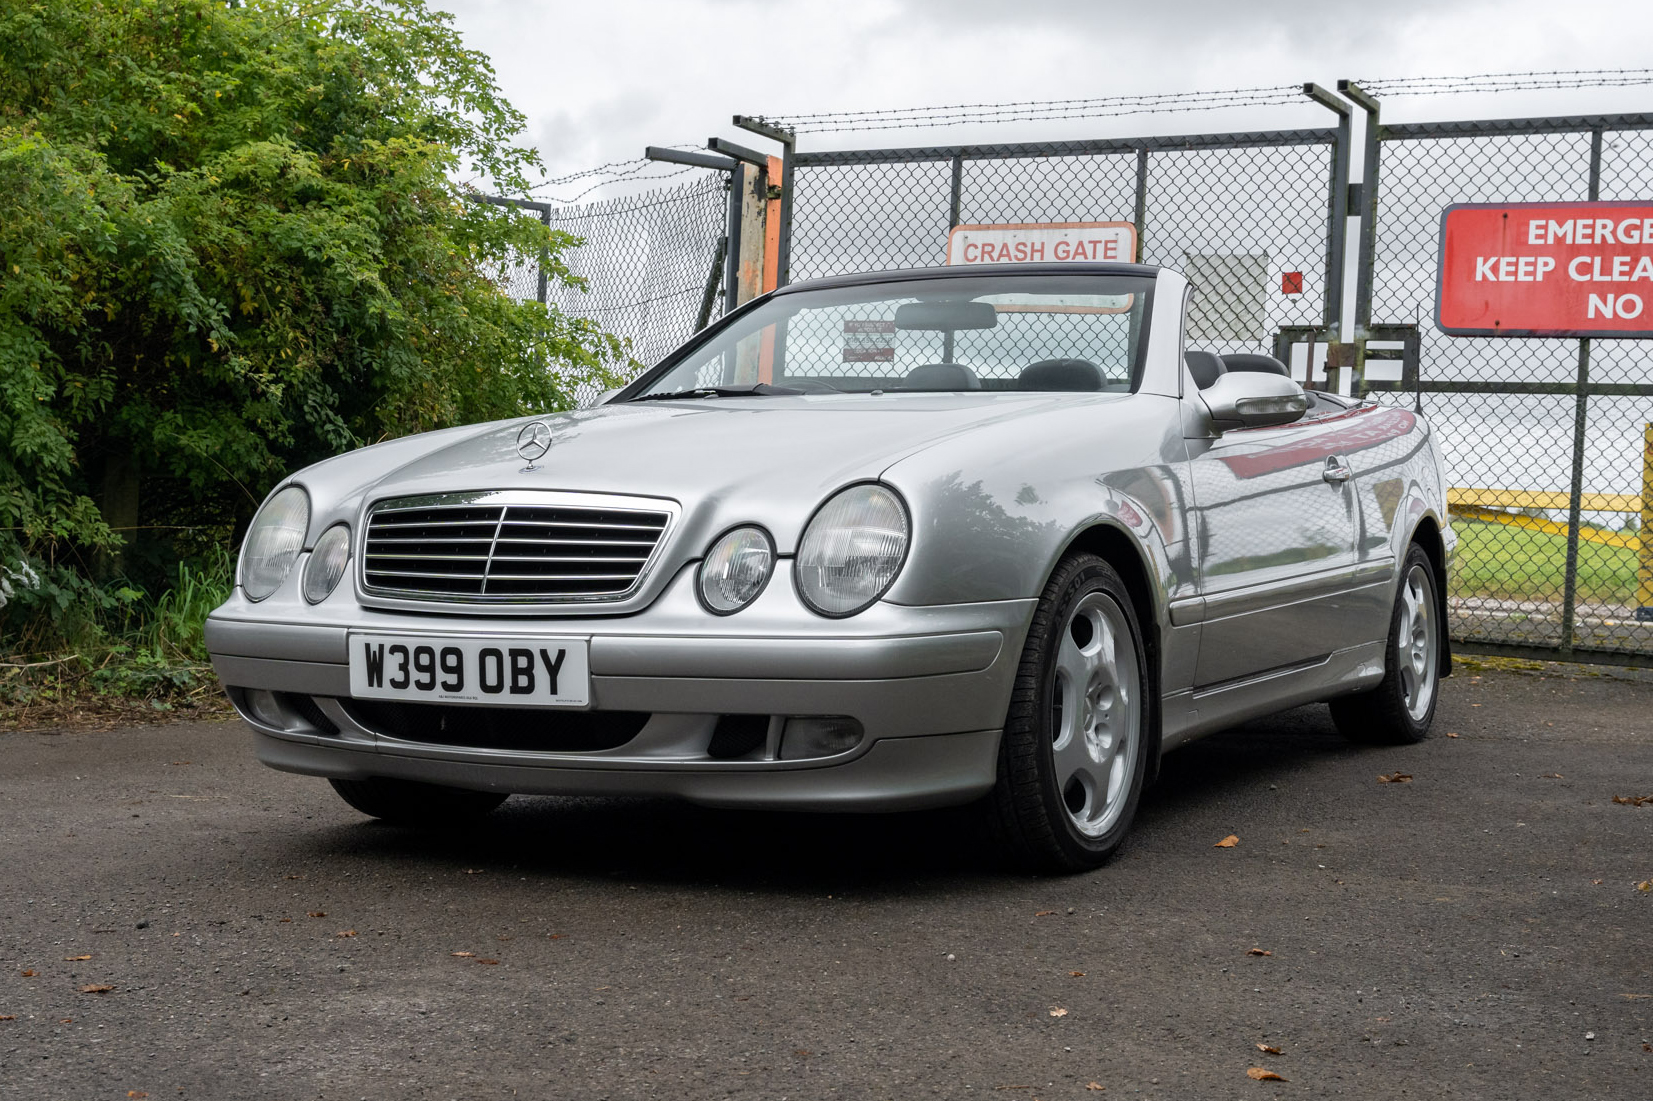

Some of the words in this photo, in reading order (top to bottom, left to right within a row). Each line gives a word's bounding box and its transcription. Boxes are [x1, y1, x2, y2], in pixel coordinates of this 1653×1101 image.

[963, 241, 1045, 263] CRASH
[1053, 239, 1118, 261] GATE
[1475, 256, 1556, 282] KEEP
[1567, 256, 1653, 282] CLEA
[1587, 293, 1644, 320] NO
[364, 642, 465, 693] W399
[478, 647, 566, 696] OBY
